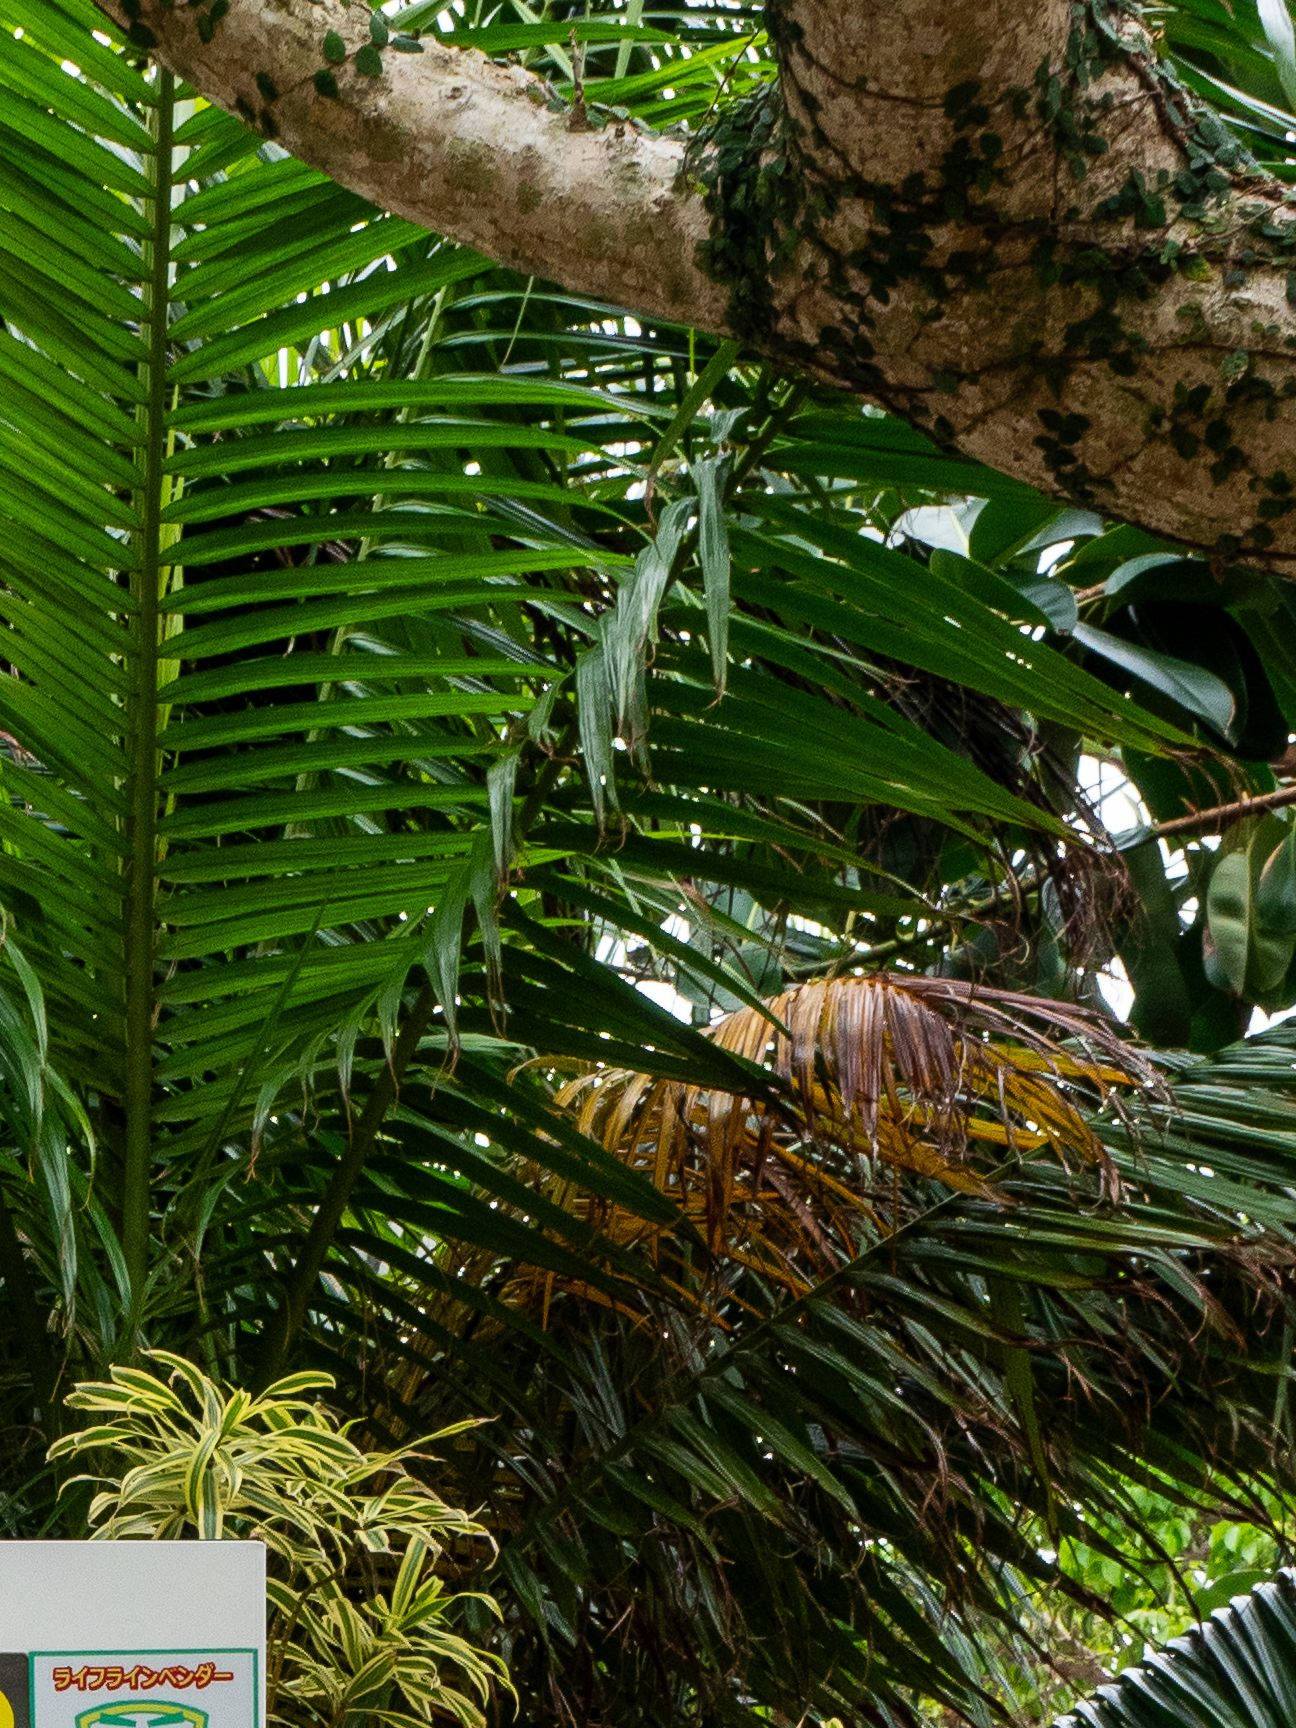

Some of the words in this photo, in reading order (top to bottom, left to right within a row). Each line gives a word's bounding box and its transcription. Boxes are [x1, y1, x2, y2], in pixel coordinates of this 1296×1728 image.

[52, 1662, 234, 1692] ライフラインベンダー
